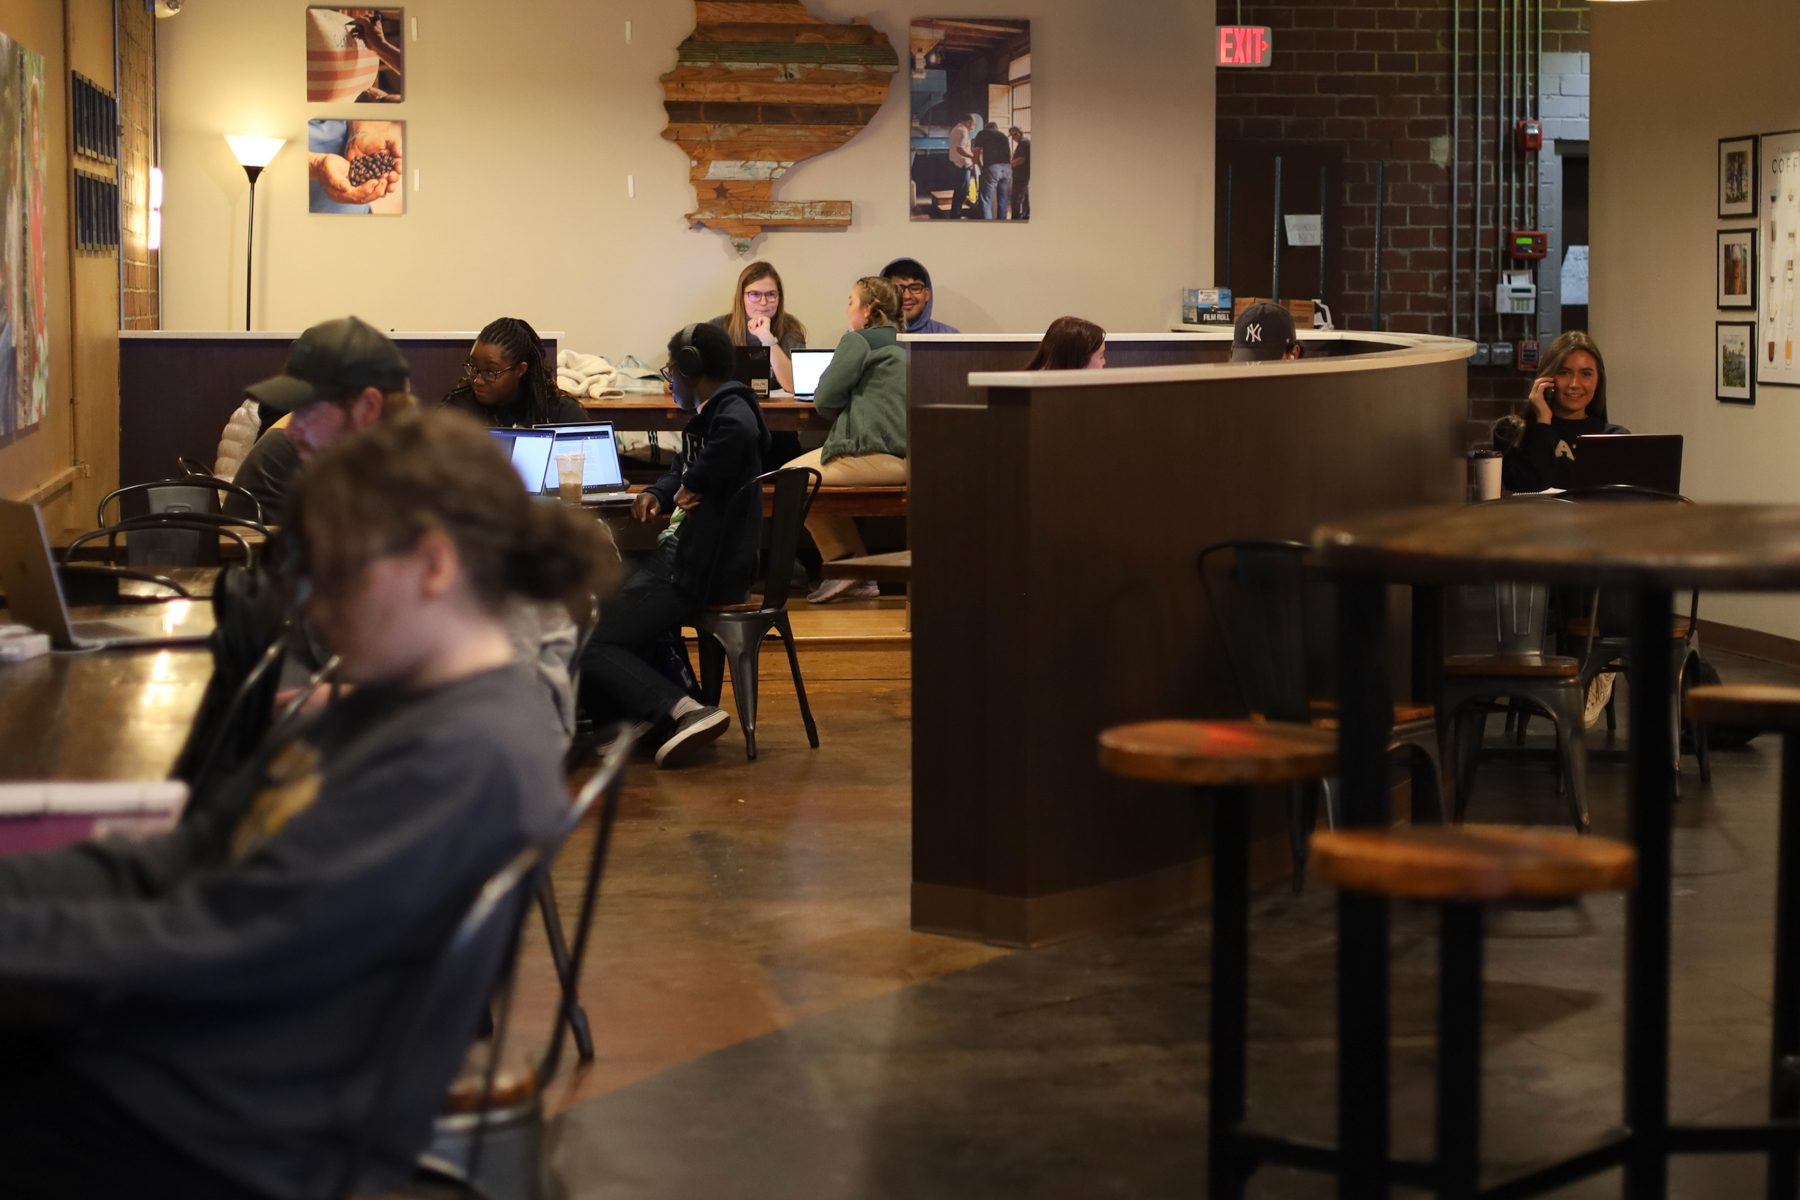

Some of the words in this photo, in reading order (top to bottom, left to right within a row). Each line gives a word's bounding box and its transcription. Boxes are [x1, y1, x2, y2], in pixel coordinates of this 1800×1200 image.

[1220, 27, 1265, 63] EXIT
[1203, 313, 1216, 321] FILM
[1217, 313, 1231, 321] ROLL
[1246, 323, 1262, 342] NY
